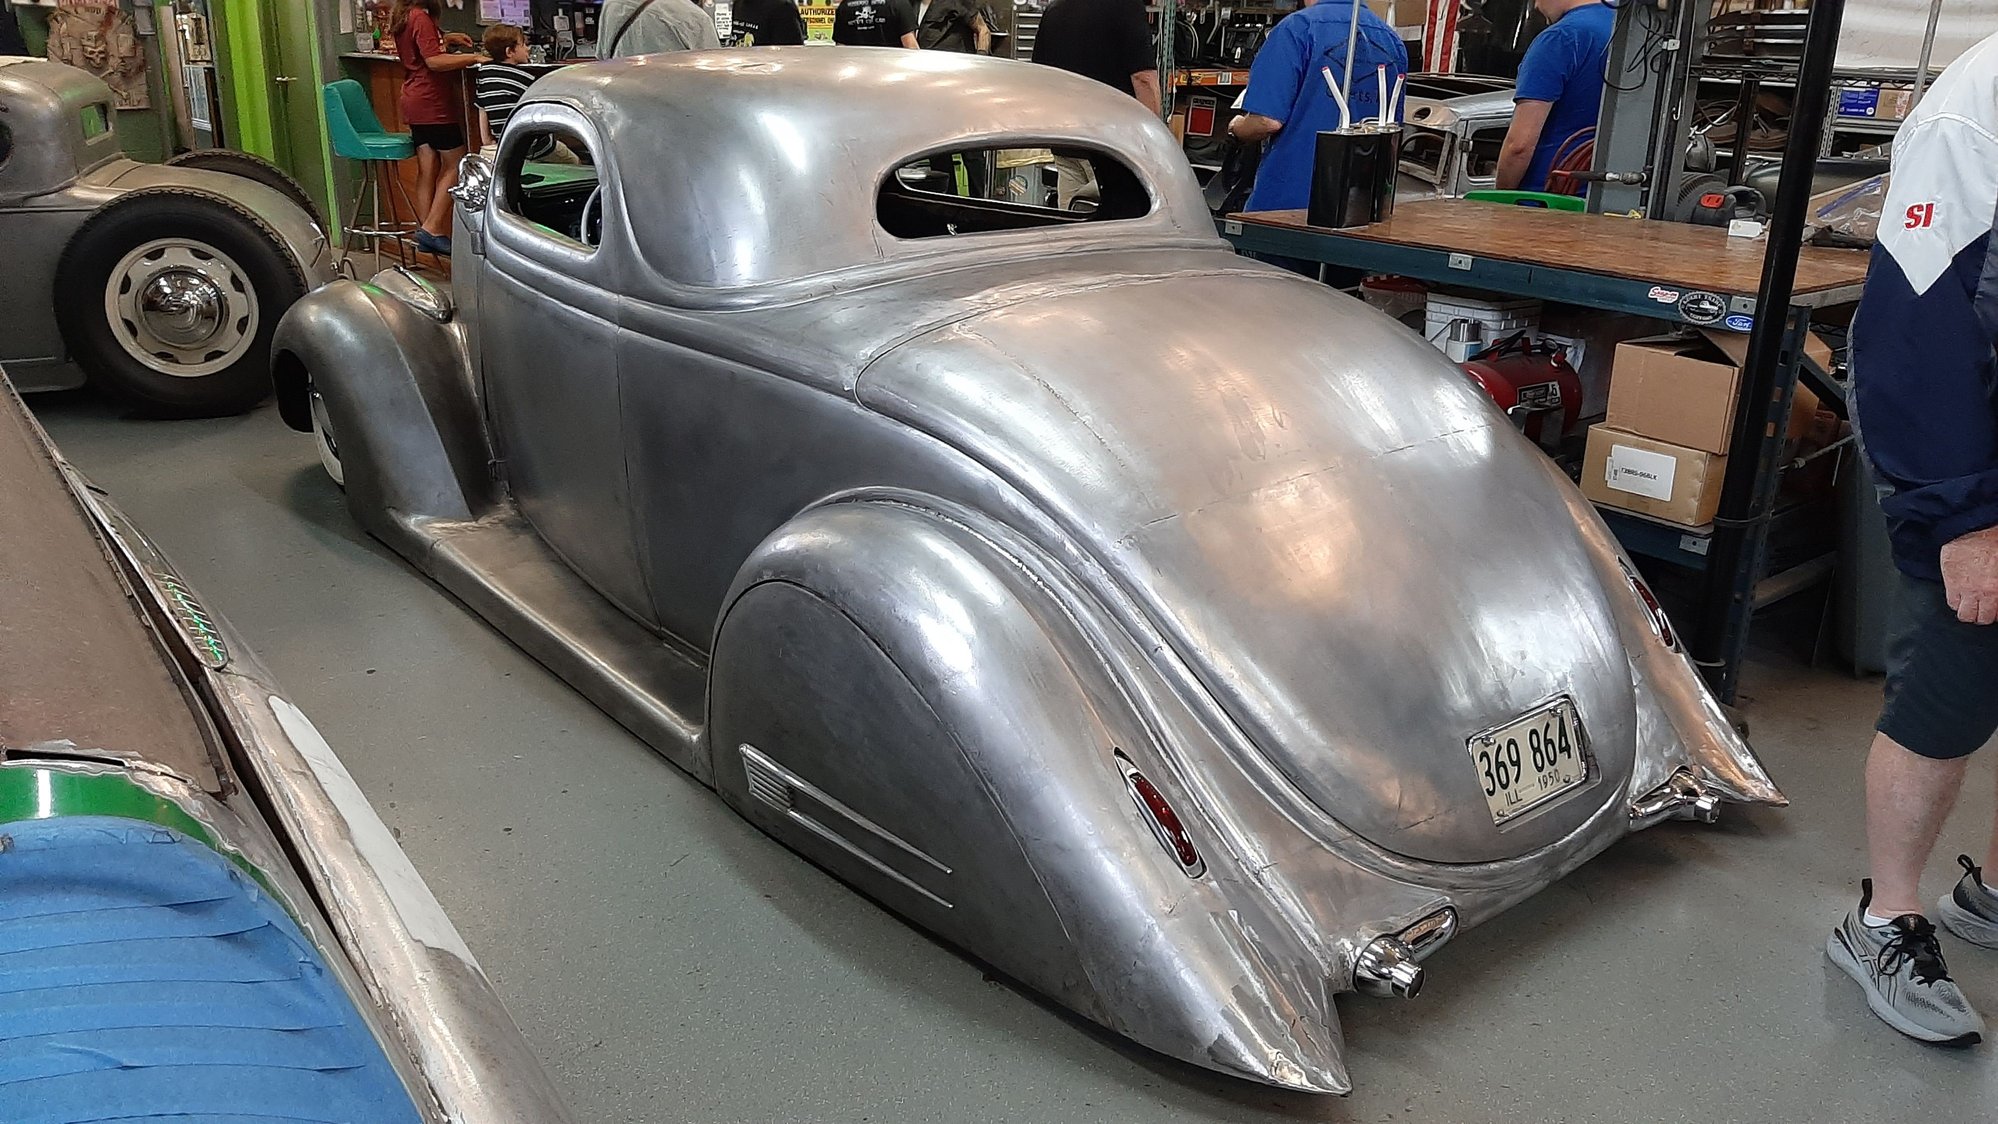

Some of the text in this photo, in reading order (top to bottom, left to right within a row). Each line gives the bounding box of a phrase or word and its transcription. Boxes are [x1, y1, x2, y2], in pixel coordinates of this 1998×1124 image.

[1904, 202, 1934, 229] SI
[1479, 713, 1572, 797] 369 864
[1505, 769, 1560, 806] ILL 1950
